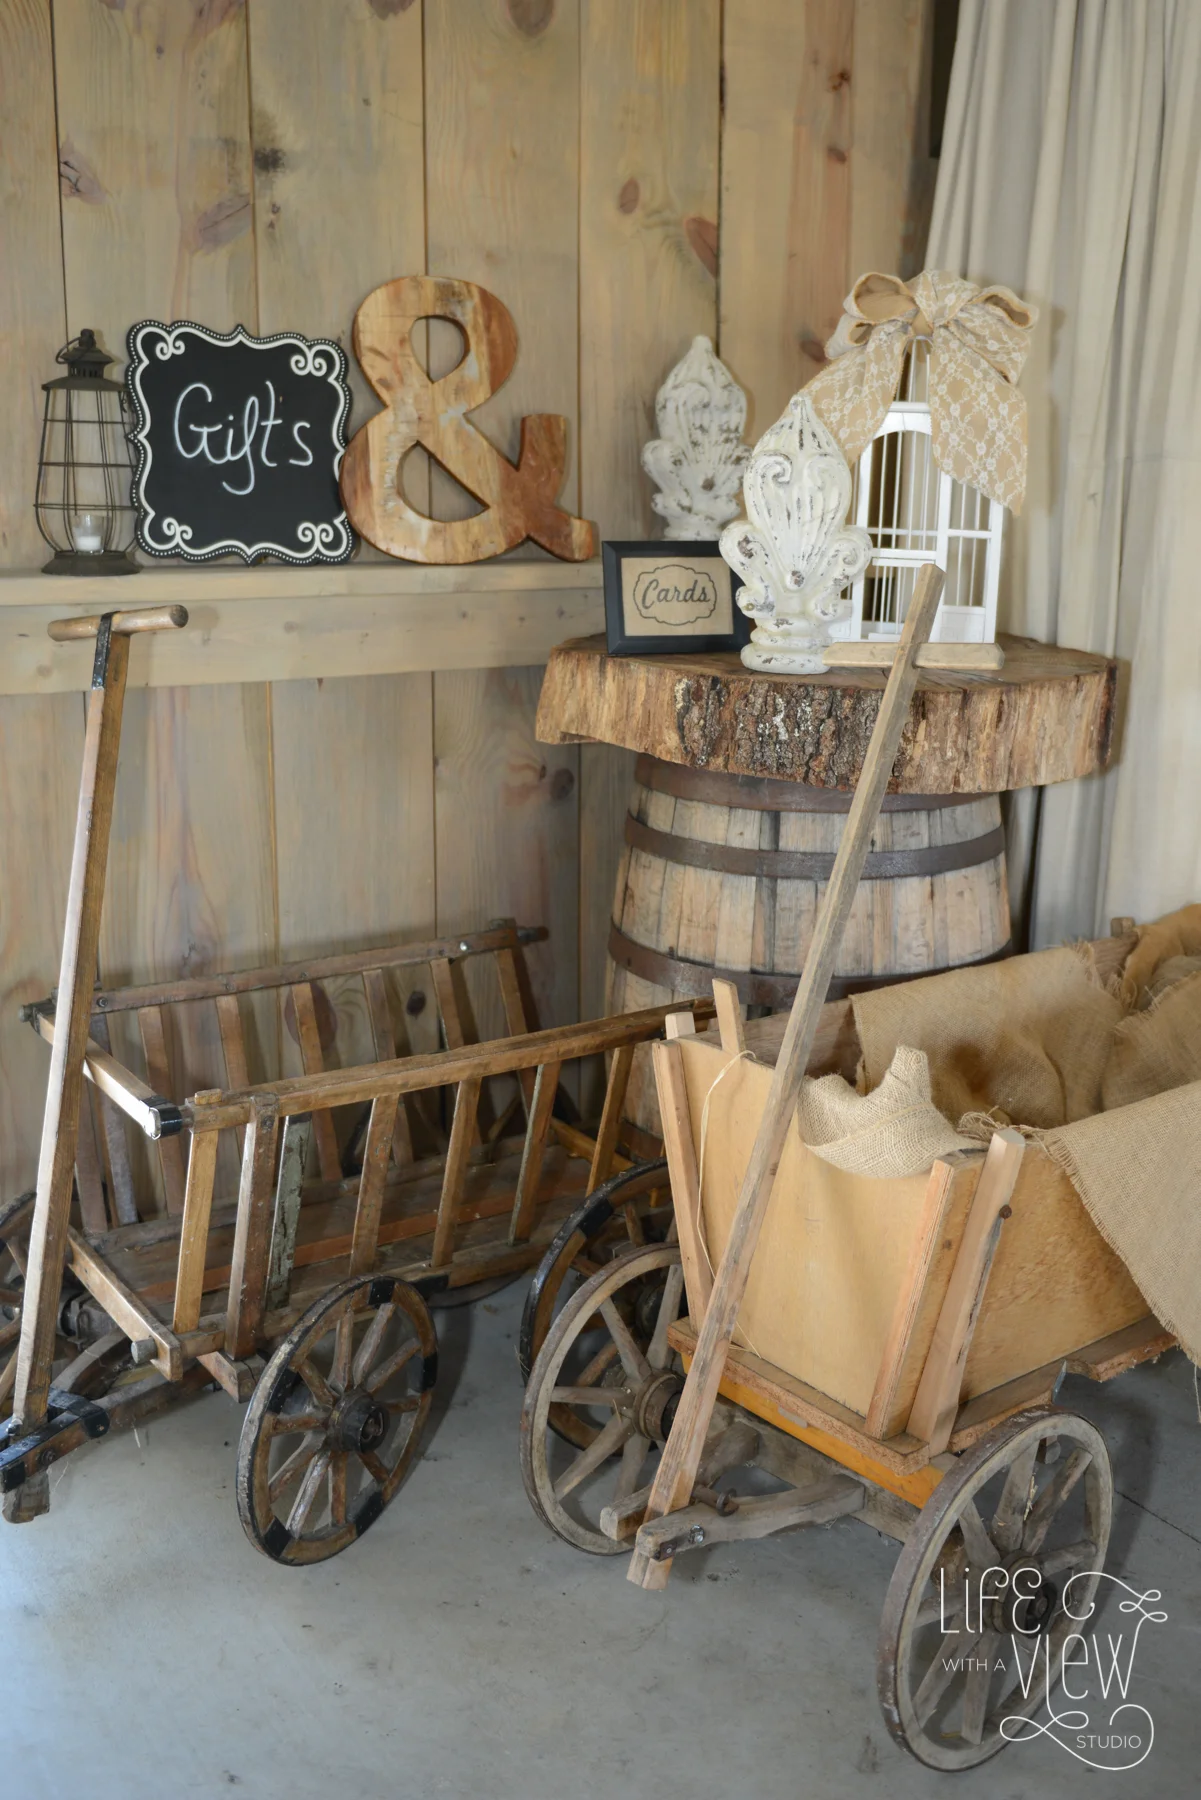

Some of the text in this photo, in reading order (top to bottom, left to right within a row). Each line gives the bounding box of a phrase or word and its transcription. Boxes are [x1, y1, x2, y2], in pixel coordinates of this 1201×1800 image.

[174, 380, 313, 495] Gifts
[339, 275, 594, 565] &
[641, 578, 711, 610] Cards
